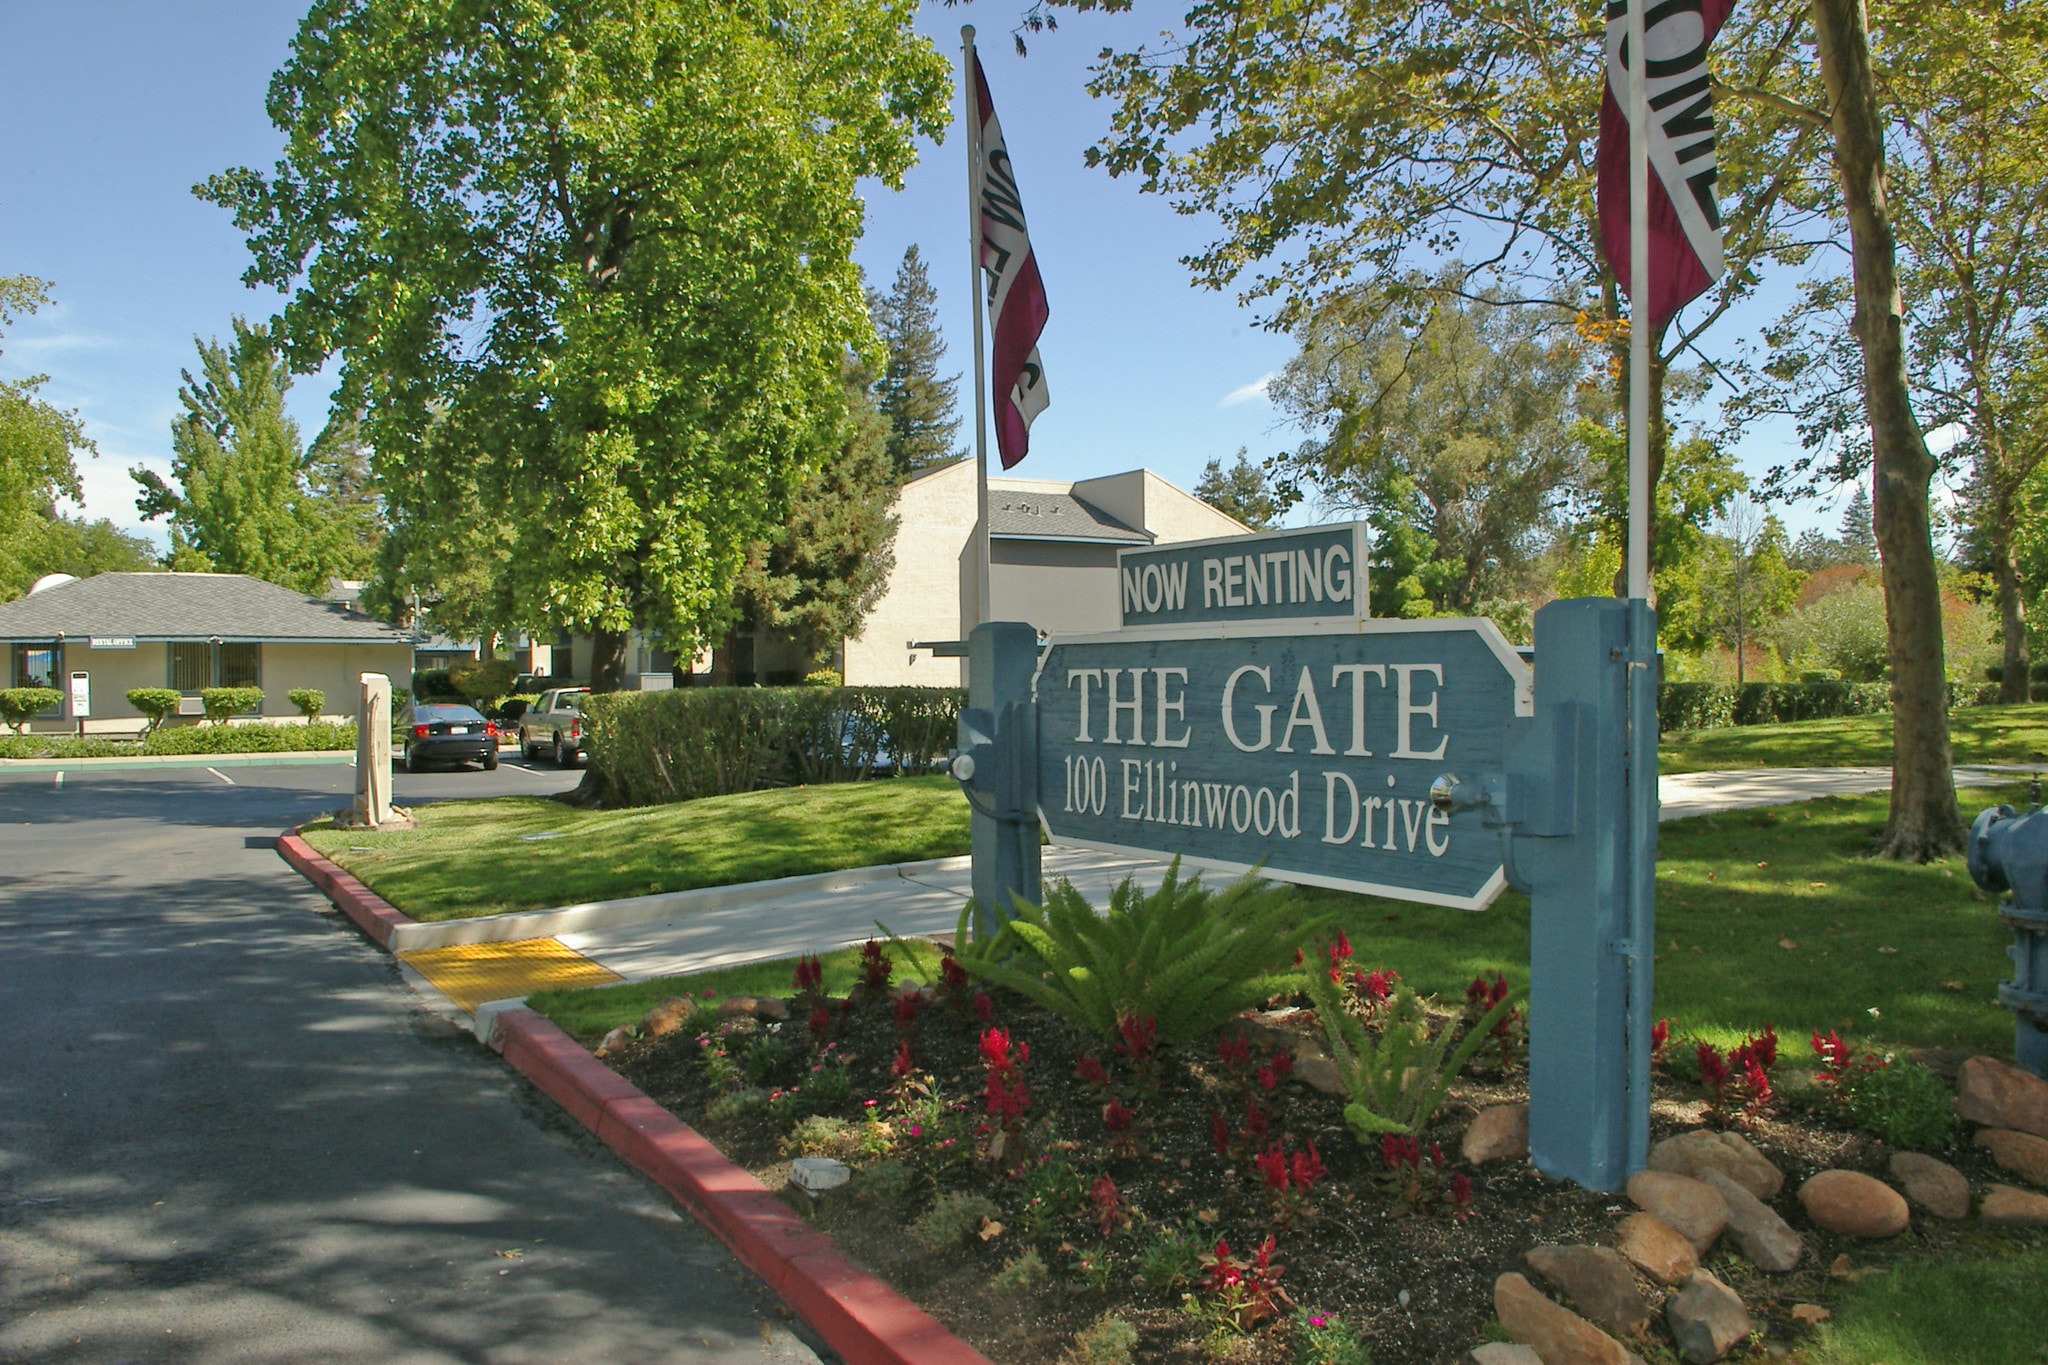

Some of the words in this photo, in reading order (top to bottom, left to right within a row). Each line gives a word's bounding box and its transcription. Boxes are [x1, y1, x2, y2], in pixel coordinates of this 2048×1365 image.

[1122, 561, 1188, 614] NOW
[1203, 544, 1352, 609] RENTING
[1067, 667, 1192, 748] THE
[1221, 663, 1449, 760] GATE
[1063, 754, 1107, 816] 100
[1120, 758, 1302, 839] Ellinwood
[1321, 771, 1450, 857] Drive
